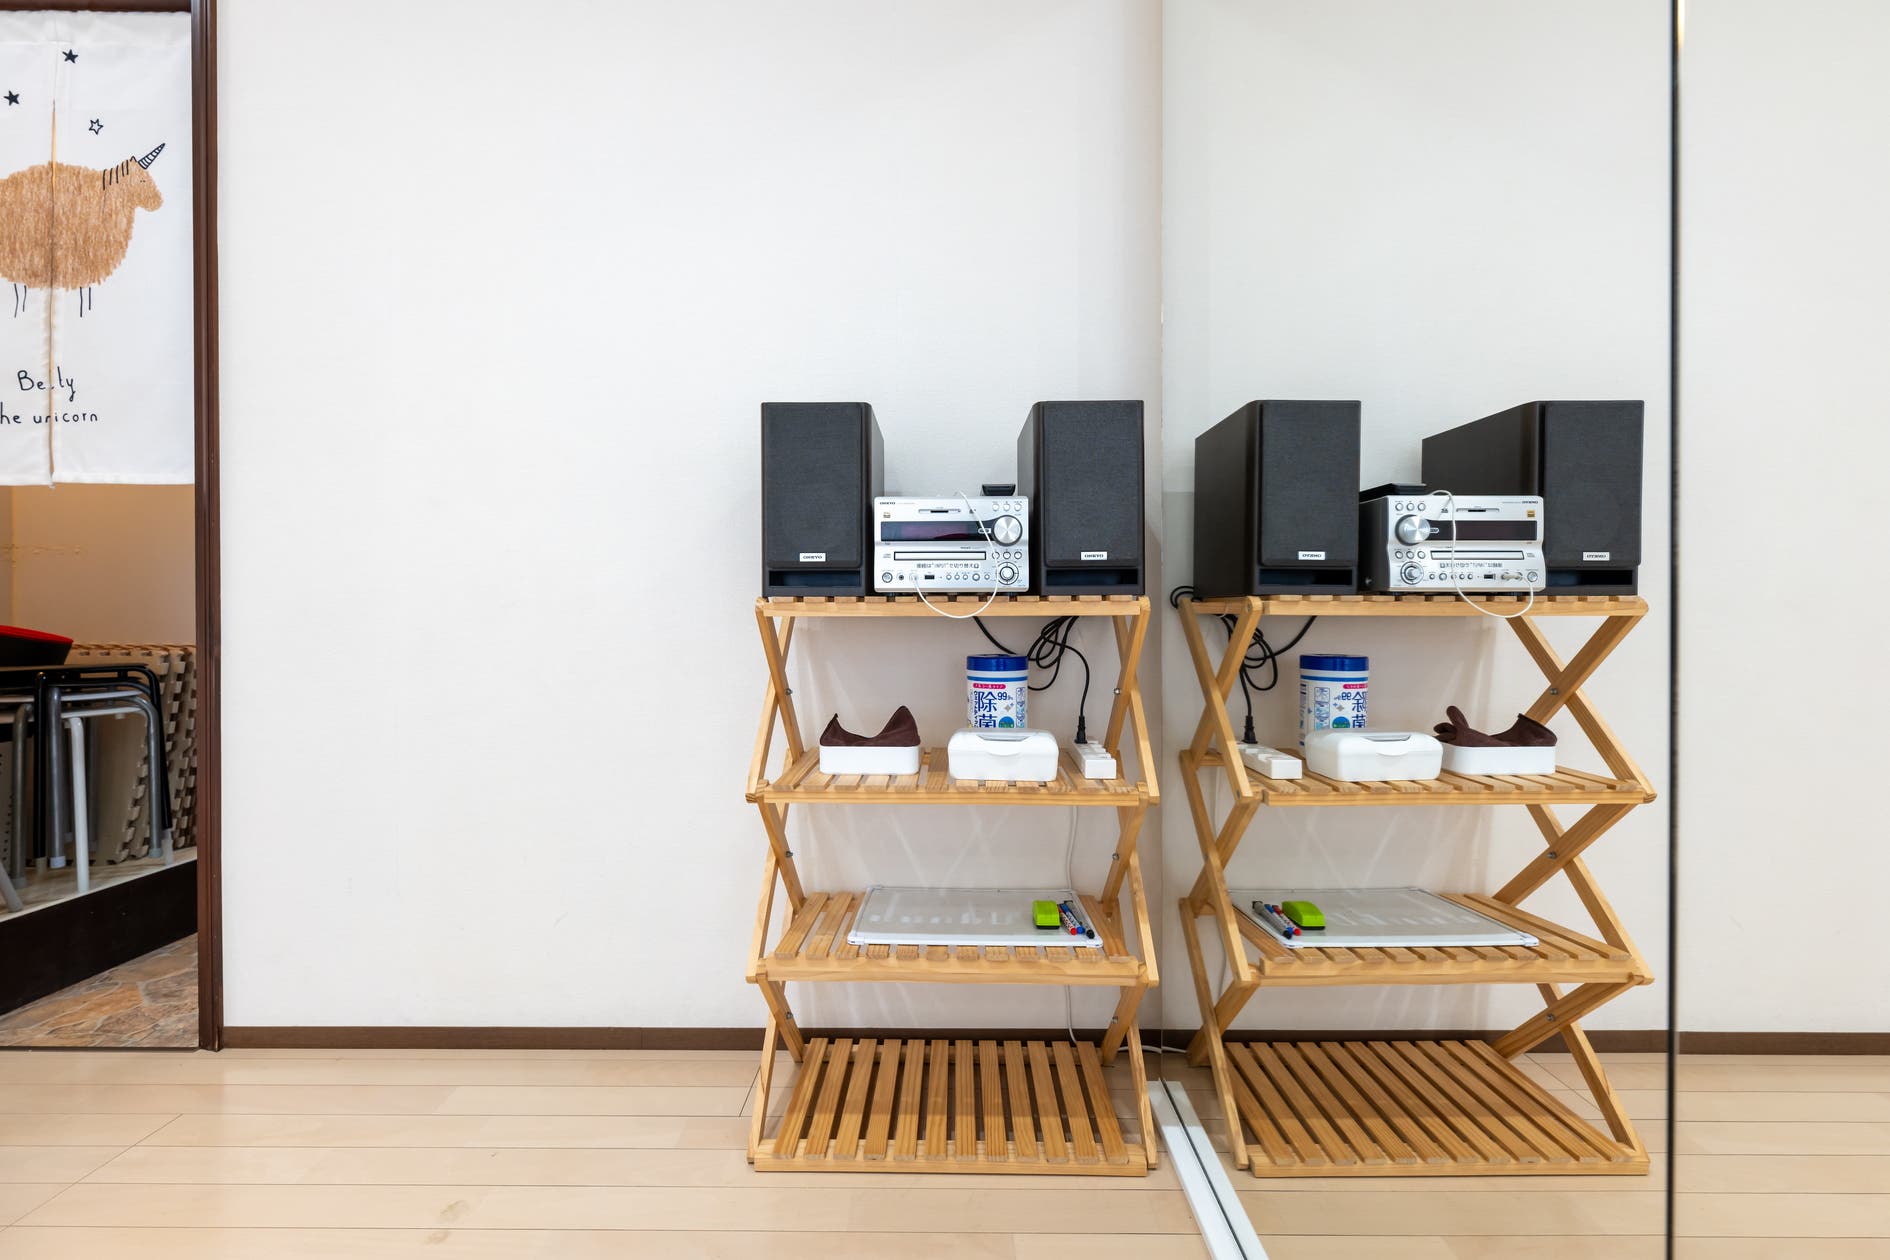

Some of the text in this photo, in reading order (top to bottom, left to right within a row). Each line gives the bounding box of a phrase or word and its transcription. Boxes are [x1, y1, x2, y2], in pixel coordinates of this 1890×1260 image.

[17, 366, 76, 402] Bely
[0, 401, 22, 424] he
[977, 691, 998, 728] 除菌
